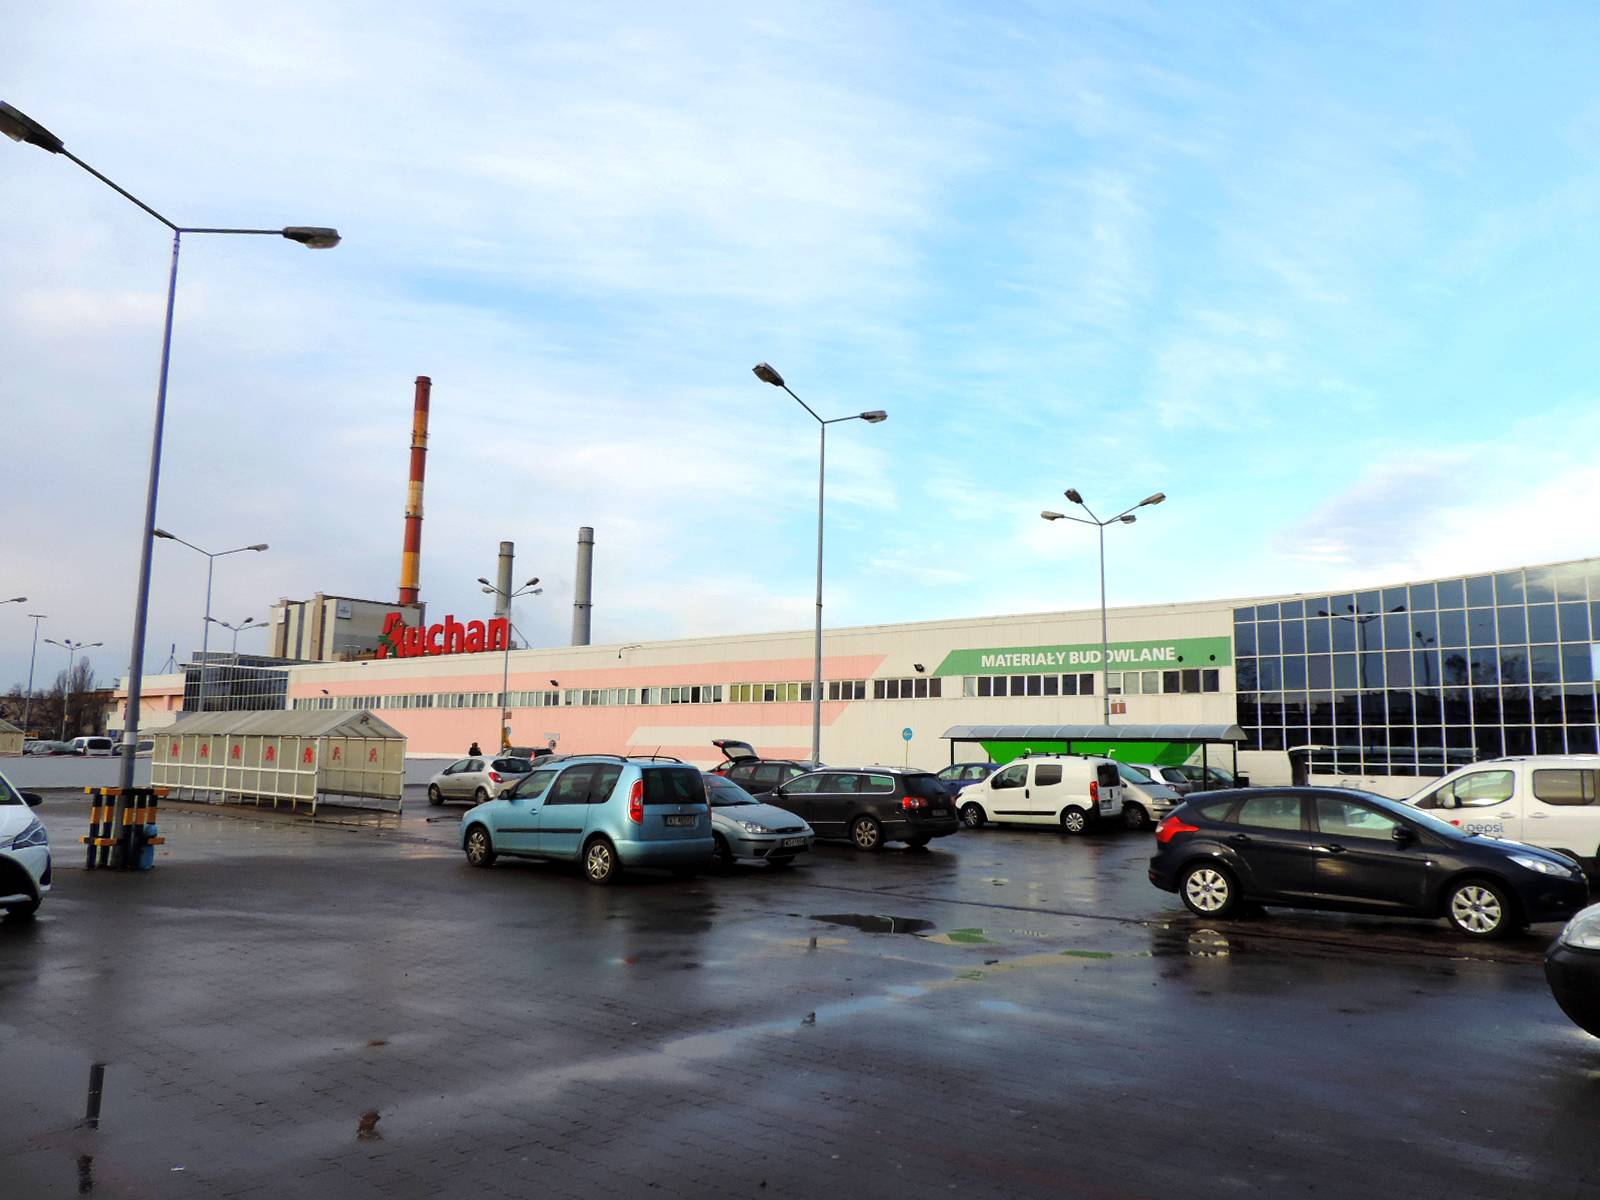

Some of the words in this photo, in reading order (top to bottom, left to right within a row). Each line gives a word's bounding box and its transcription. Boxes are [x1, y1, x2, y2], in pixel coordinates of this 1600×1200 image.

[376, 612, 508, 659] Auchan
[981, 651, 1066, 667] MATERIAŁY
[1069, 647, 1175, 665] BUDOWLANE
[1467, 823, 1504, 834] pepsi
